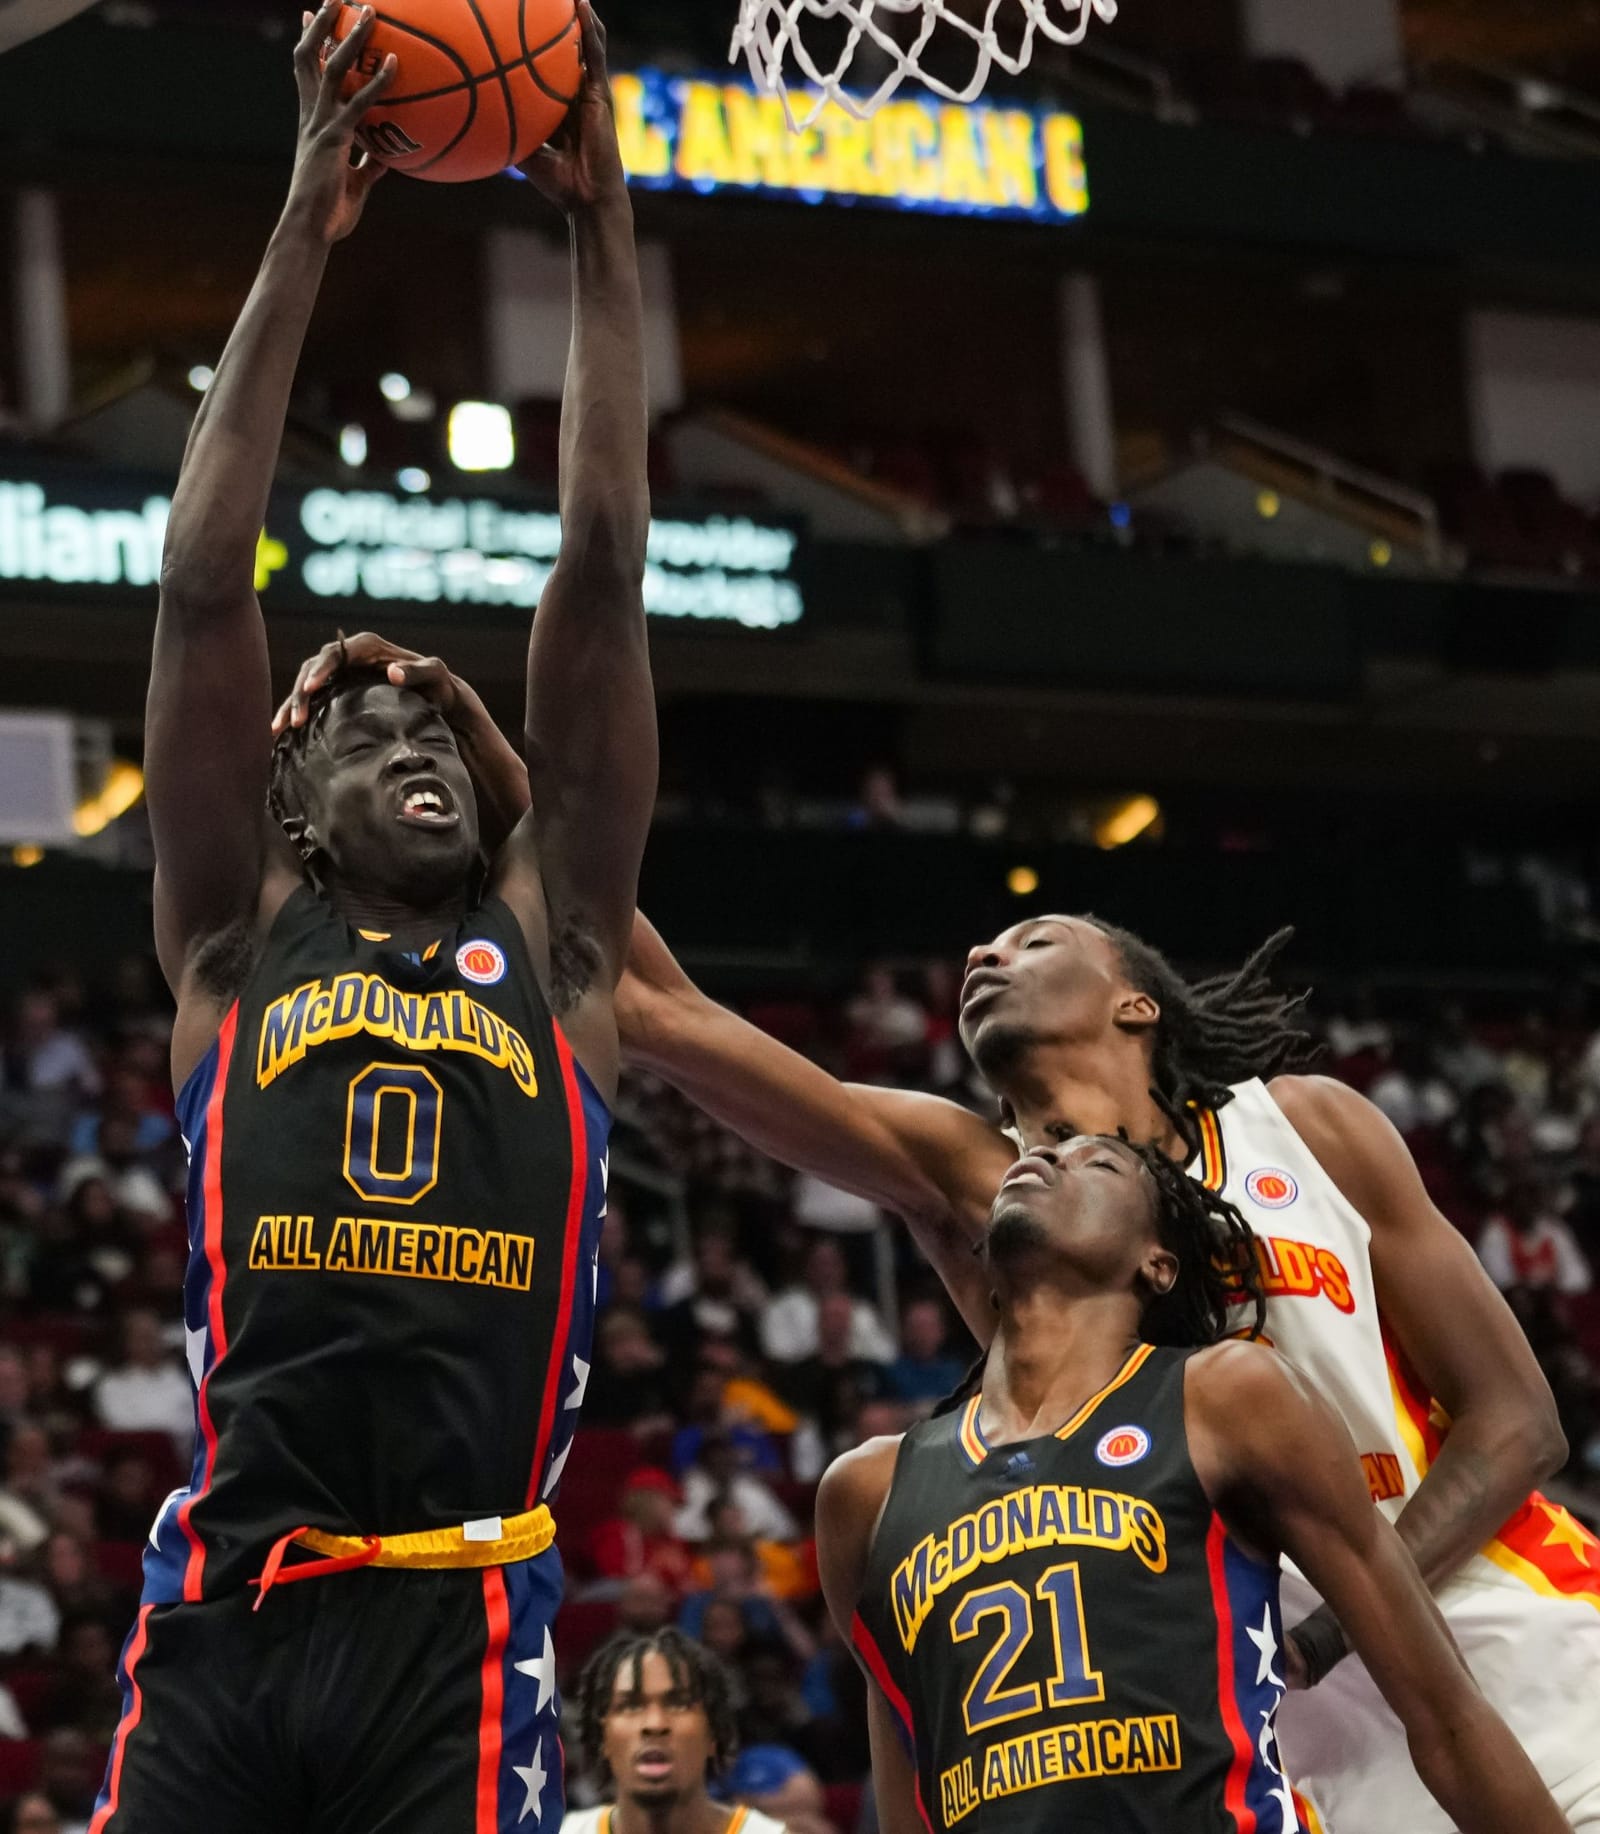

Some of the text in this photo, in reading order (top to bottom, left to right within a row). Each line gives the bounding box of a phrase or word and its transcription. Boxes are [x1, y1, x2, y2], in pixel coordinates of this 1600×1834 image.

[675, 80, 1037, 208] AMERICAN
[256, 972, 538, 1098] McDONALD'S
[343, 1061, 443, 1205] 0
[249, 1215, 534, 1292] ALL AMERICAN
[891, 1484, 1168, 1655] McDONALD'S
[949, 1561, 1105, 1736] 21
[940, 1714, 1182, 1828] ALL AMERICAN
